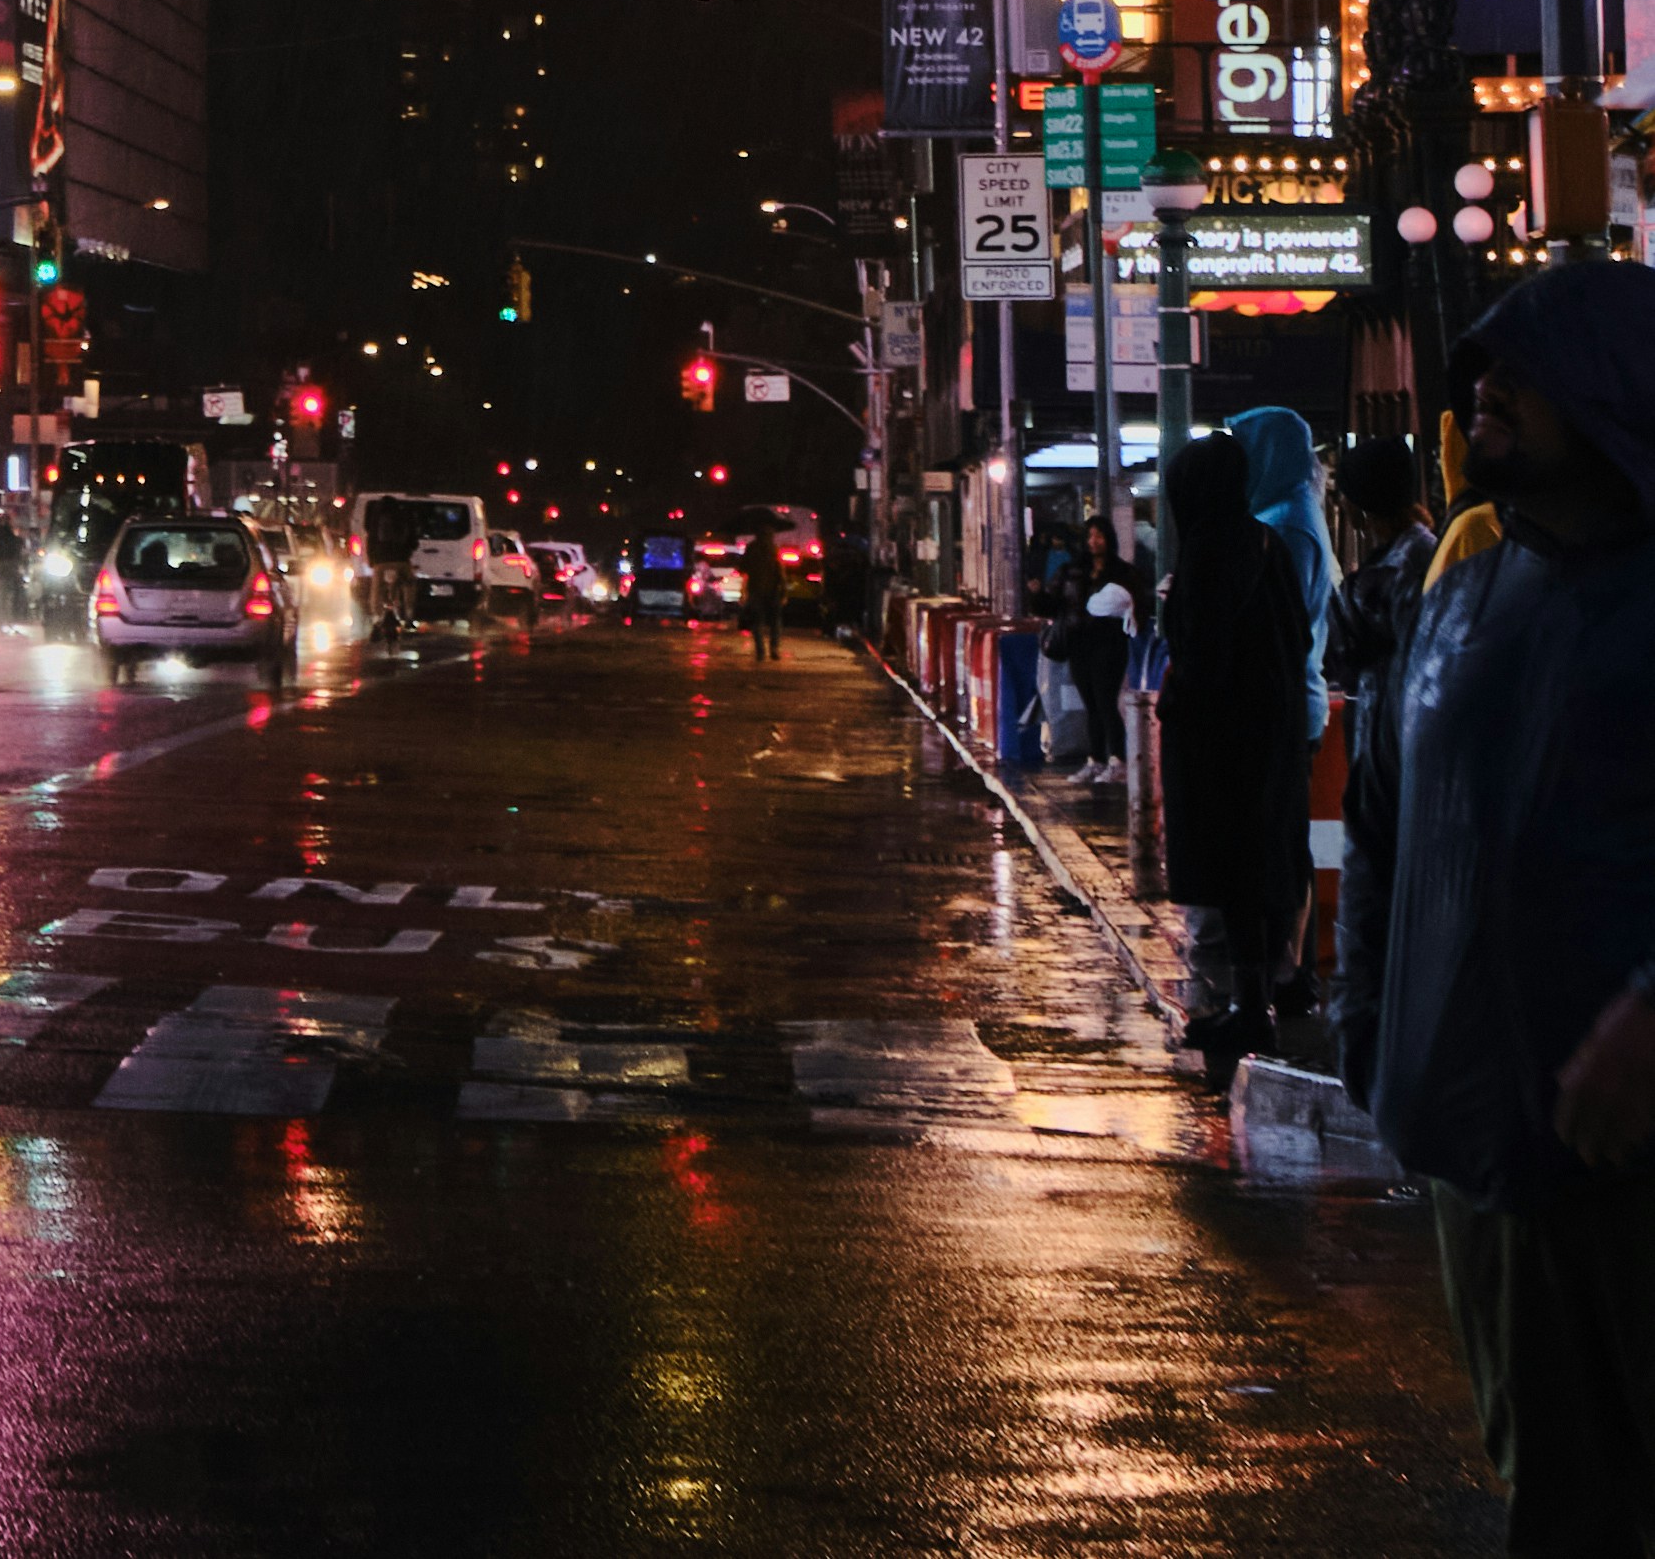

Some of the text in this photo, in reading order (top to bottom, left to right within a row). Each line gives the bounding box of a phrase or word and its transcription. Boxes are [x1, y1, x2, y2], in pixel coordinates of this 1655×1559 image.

[890, 27, 985, 47] NEW 42
[985, 162, 1021, 174] CITY
[978, 179, 1031, 191] SPEED
[984, 195, 1025, 208] LIMIT
[975, 214, 1040, 252] 25
[1242, 228, 1262, 248] is
[1264, 227, 1359, 251] powered
[1187, 254, 1275, 278] onprofit
[1276, 253, 1328, 274] New
[1329, 253, 1366, 274] 42.
[984, 268, 1031, 279] PHOTO
[971, 281, 1045, 292] ENFORCED
